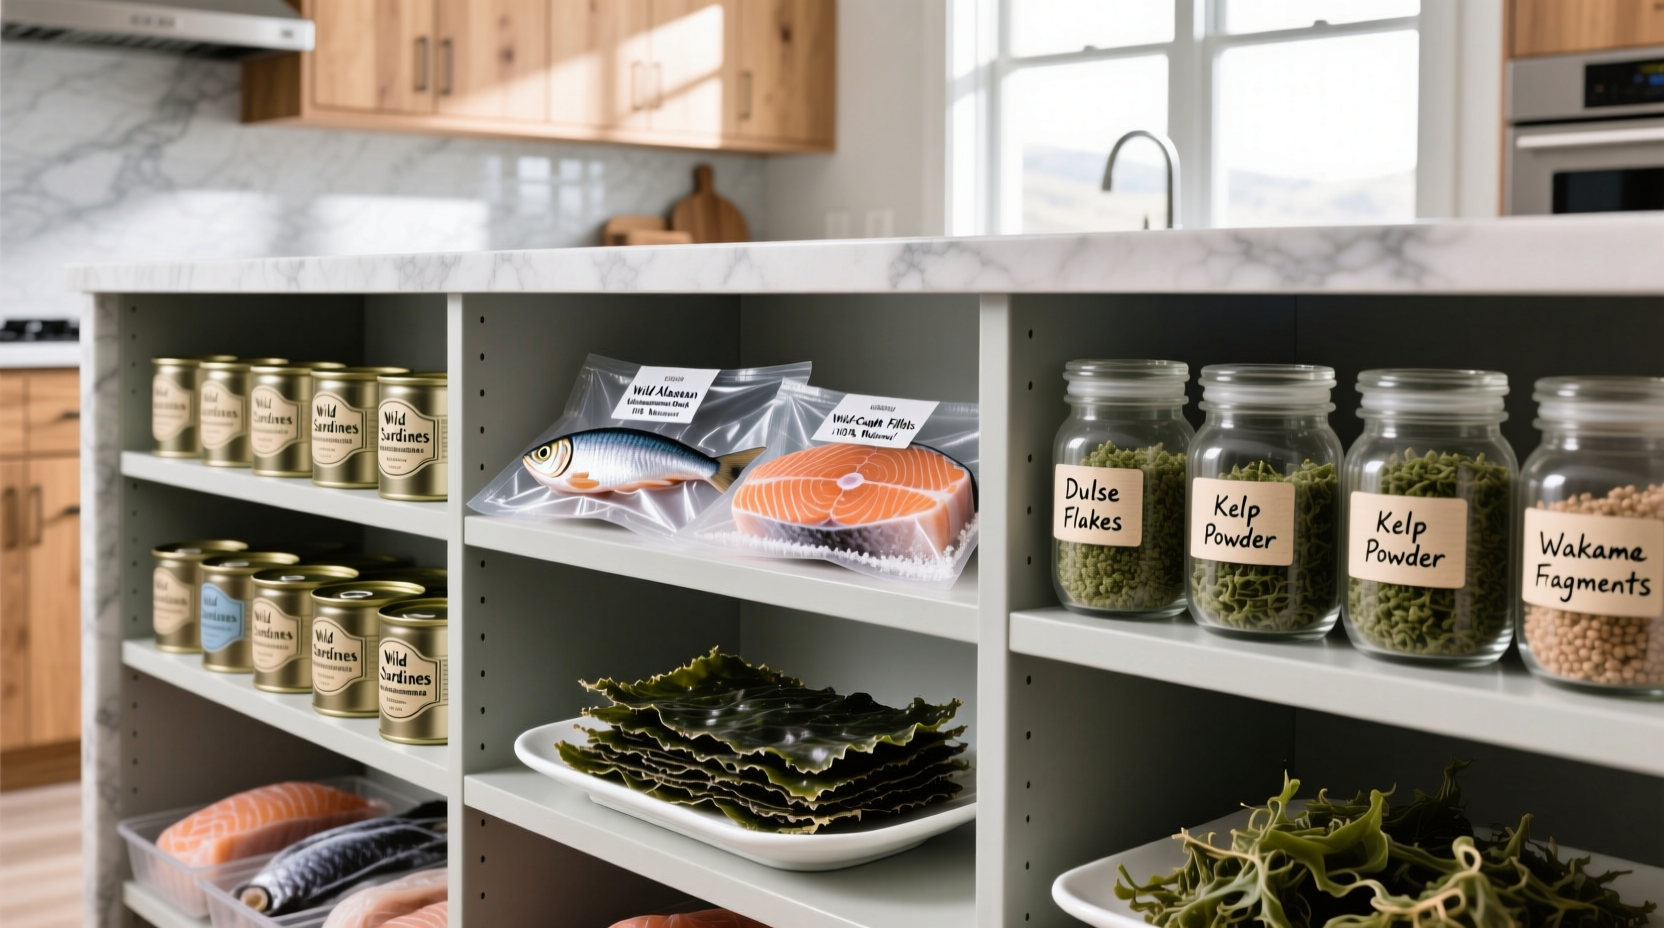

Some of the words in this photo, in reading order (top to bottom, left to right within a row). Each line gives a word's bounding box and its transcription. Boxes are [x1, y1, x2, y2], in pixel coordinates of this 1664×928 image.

[316, 403, 337, 418] Wild
[384, 410, 406, 426] Wild
[313, 419, 359, 434] Sardines
[381, 427, 430, 443] Sardines
[1065, 477, 1120, 502] Dulse
[1064, 506, 1122, 531] Flakes
[1214, 494, 1261, 527] Kelp
[1204, 523, 1277, 549] Powder
[1376, 510, 1427, 544] Kelp
[1365, 538, 1446, 568] Powder
[1540, 531, 1648, 562] Wakame
[384, 649, 407, 667] Wild
[380, 666, 432, 685] Sardines
